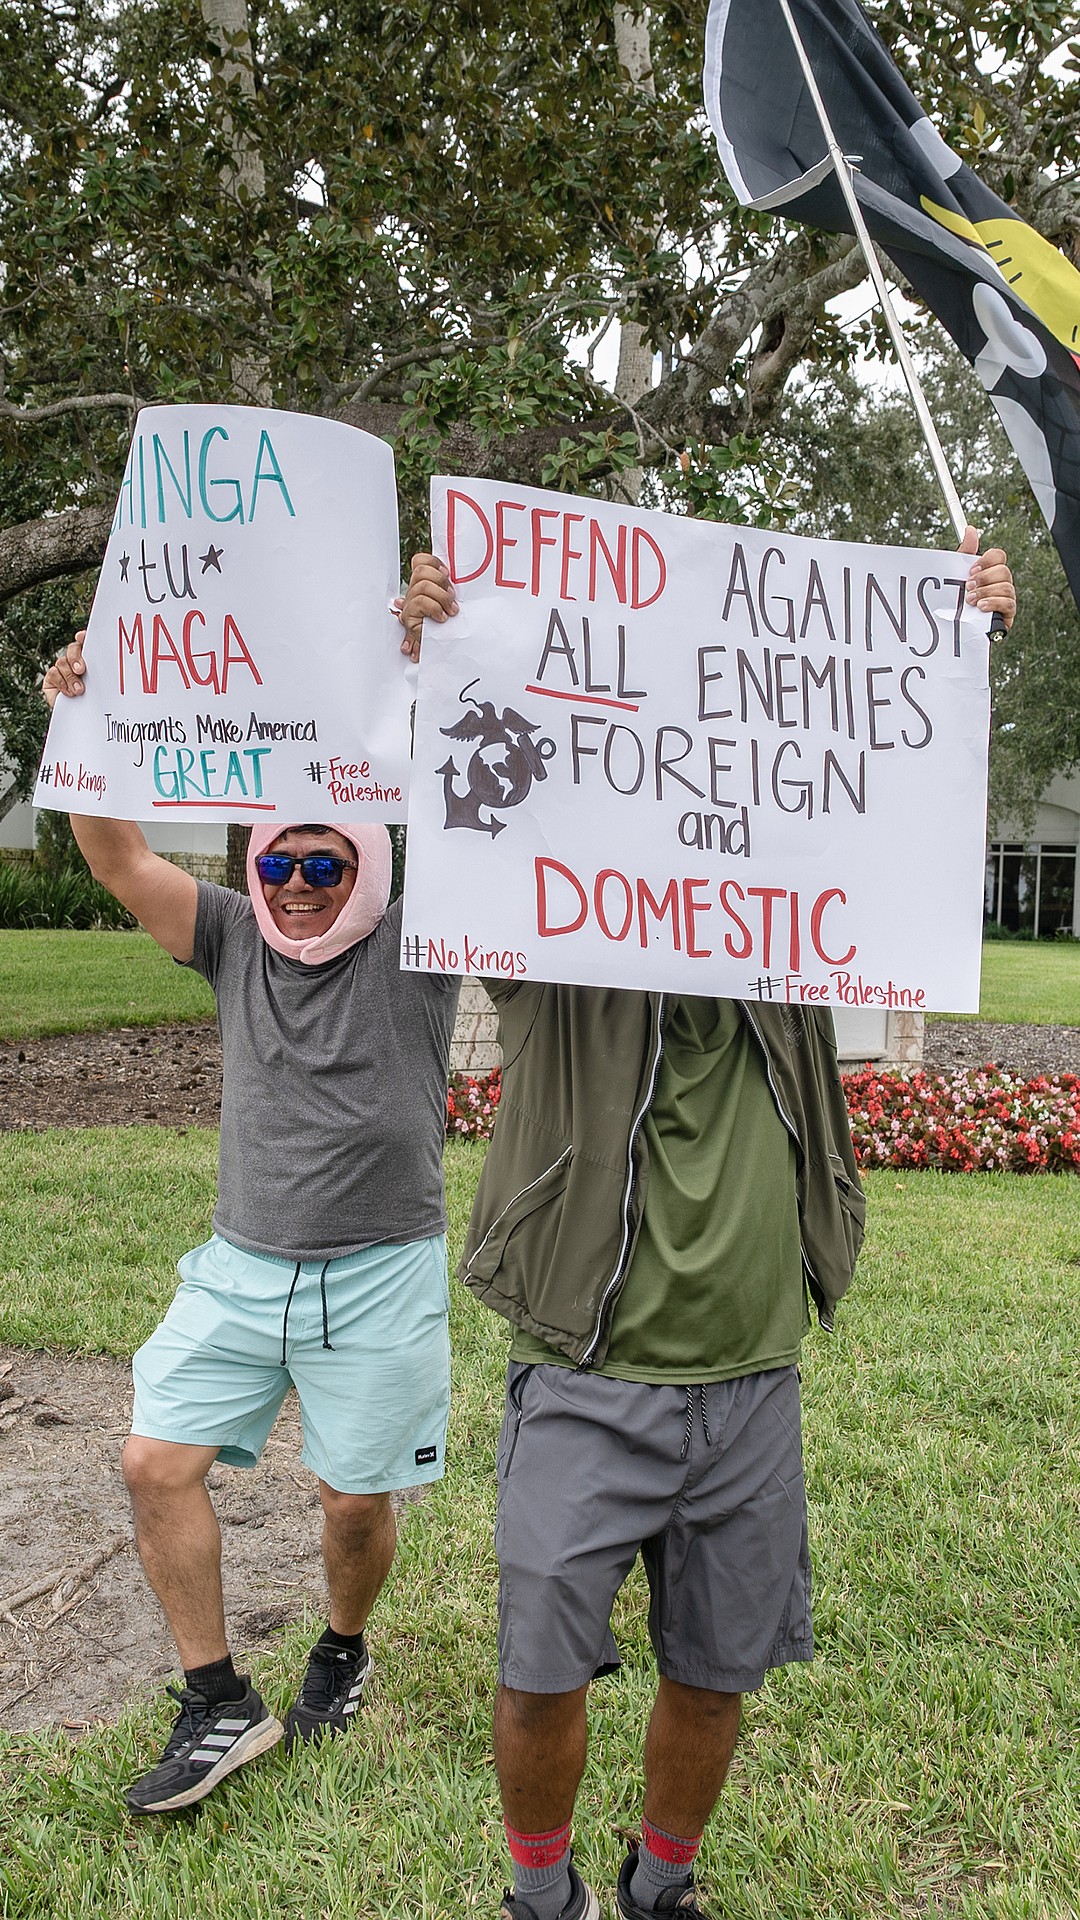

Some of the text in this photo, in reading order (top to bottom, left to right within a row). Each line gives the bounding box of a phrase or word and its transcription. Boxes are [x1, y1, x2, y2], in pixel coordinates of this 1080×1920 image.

[109, 426, 296, 535] HINGA
[138, 538, 198, 604] tu
[447, 489, 967, 658] DEFEND AGAINST
[118, 610, 264, 695] MAGA
[536, 607, 933, 751] ALL ENEMIES
[105, 712, 318, 768] Immigrants Make America
[153, 745, 272, 802] GREAT
[303, 756, 370, 785] #Free
[571, 714, 867, 820] FOREIGN
[327, 780, 403, 805] Palestine
[678, 805, 751, 858] and
[535, 856, 857, 971] DOMESTIC
